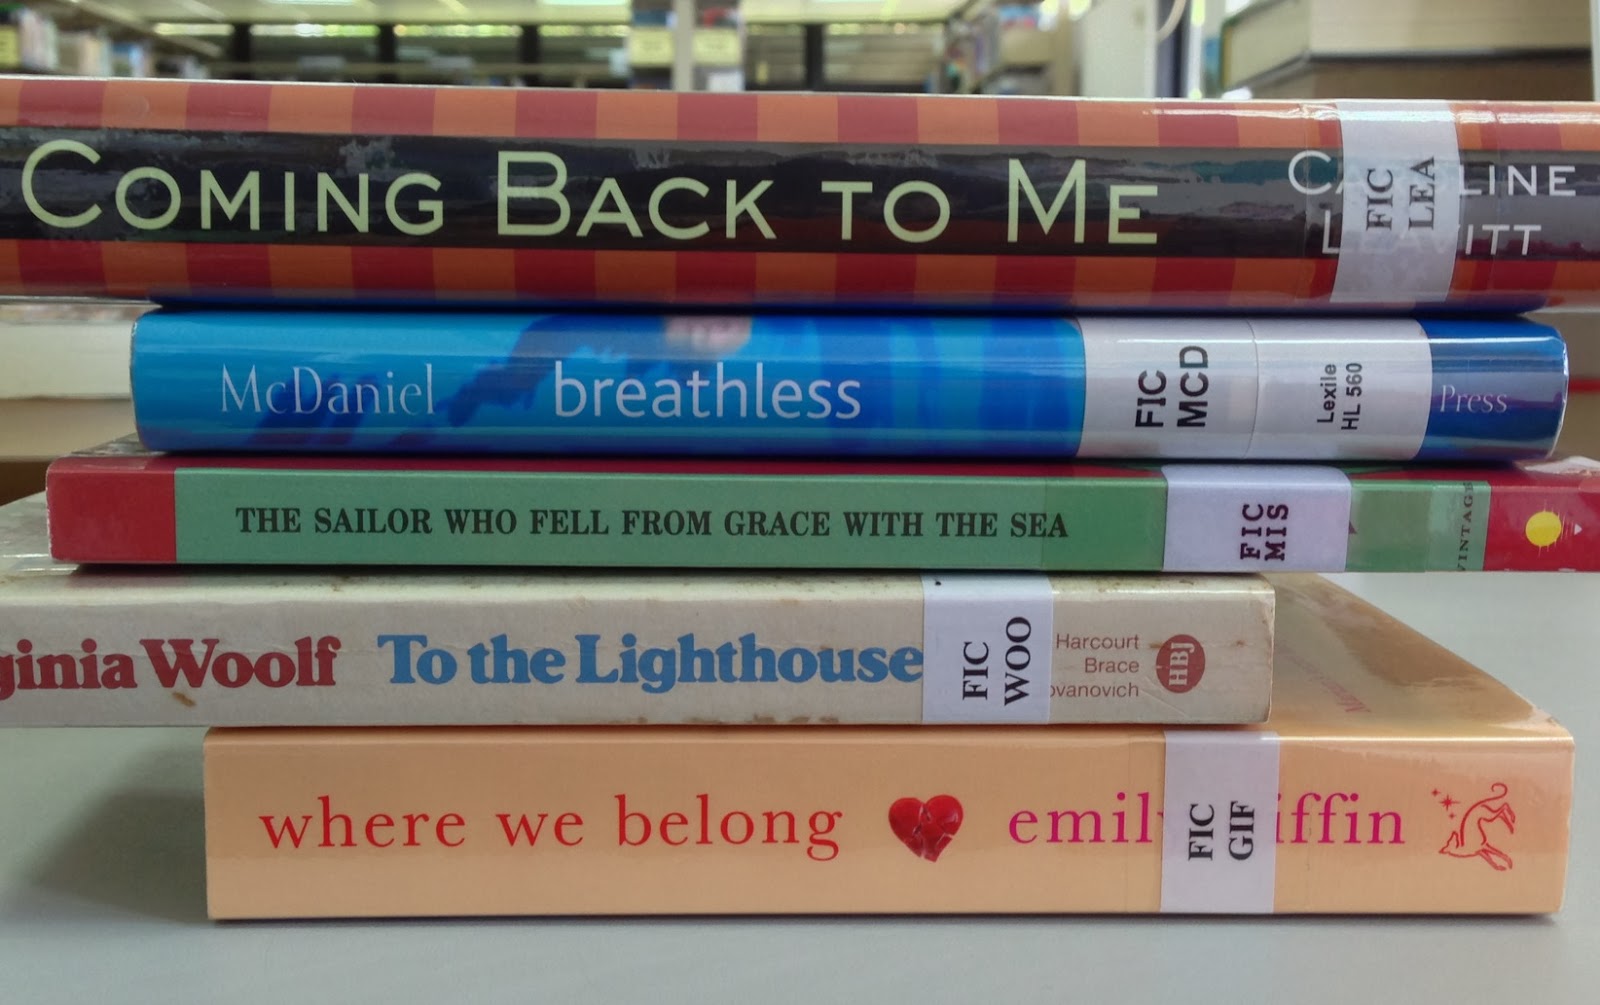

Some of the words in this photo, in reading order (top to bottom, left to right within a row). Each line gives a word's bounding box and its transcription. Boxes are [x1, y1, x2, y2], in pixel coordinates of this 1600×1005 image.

[822, 180, 951, 244] TO
[1366, 168, 1394, 231] FIC
[1408, 156, 1436, 230] LEA
[221, 363, 436, 416] McDaniel
[554, 360, 863, 420] breathless
[1135, 370, 1167, 428] FIC
[1177, 345, 1209, 427] MCD
[1317, 363, 1337, 424] Lexile
[1346, 362, 1362, 398] 560
[1440, 384, 1508, 414] Press
[1341, 404, 1361, 430] HL
[236, 507, 301, 534] THE
[315, 507, 433, 534] SAILOR
[444, 508, 517, 535] WHO
[529, 509, 609, 536] FELL
[621, 510, 712, 536] FROM
[724, 510, 831, 537] GRACE
[843, 511, 924, 538] WITH
[936, 511, 998, 539] THE
[1010, 512, 1069, 539] SEA
[1240, 503, 1264, 561] FIC
[1264, 503, 1289, 562] MIS
[139, 635, 342, 689] Woolf
[378, 634, 458, 685] To
[467, 633, 567, 685] the
[575, 632, 924, 694] Lighthouse
[1004, 616, 1033, 706] WOO
[1056, 633, 1140, 650] Harcourt
[1084, 657, 1140, 674] Brace
[1168, 642, 1195, 686] HBJ
[962, 641, 990, 701] FIC
[258, 795, 466, 849] where
[495, 810, 585, 849] we
[613, 793, 844, 862] belong
[1008, 792, 1164, 844] emil
[1188, 803, 1216, 861] FIC
[1228, 800, 1256, 861] GIF
